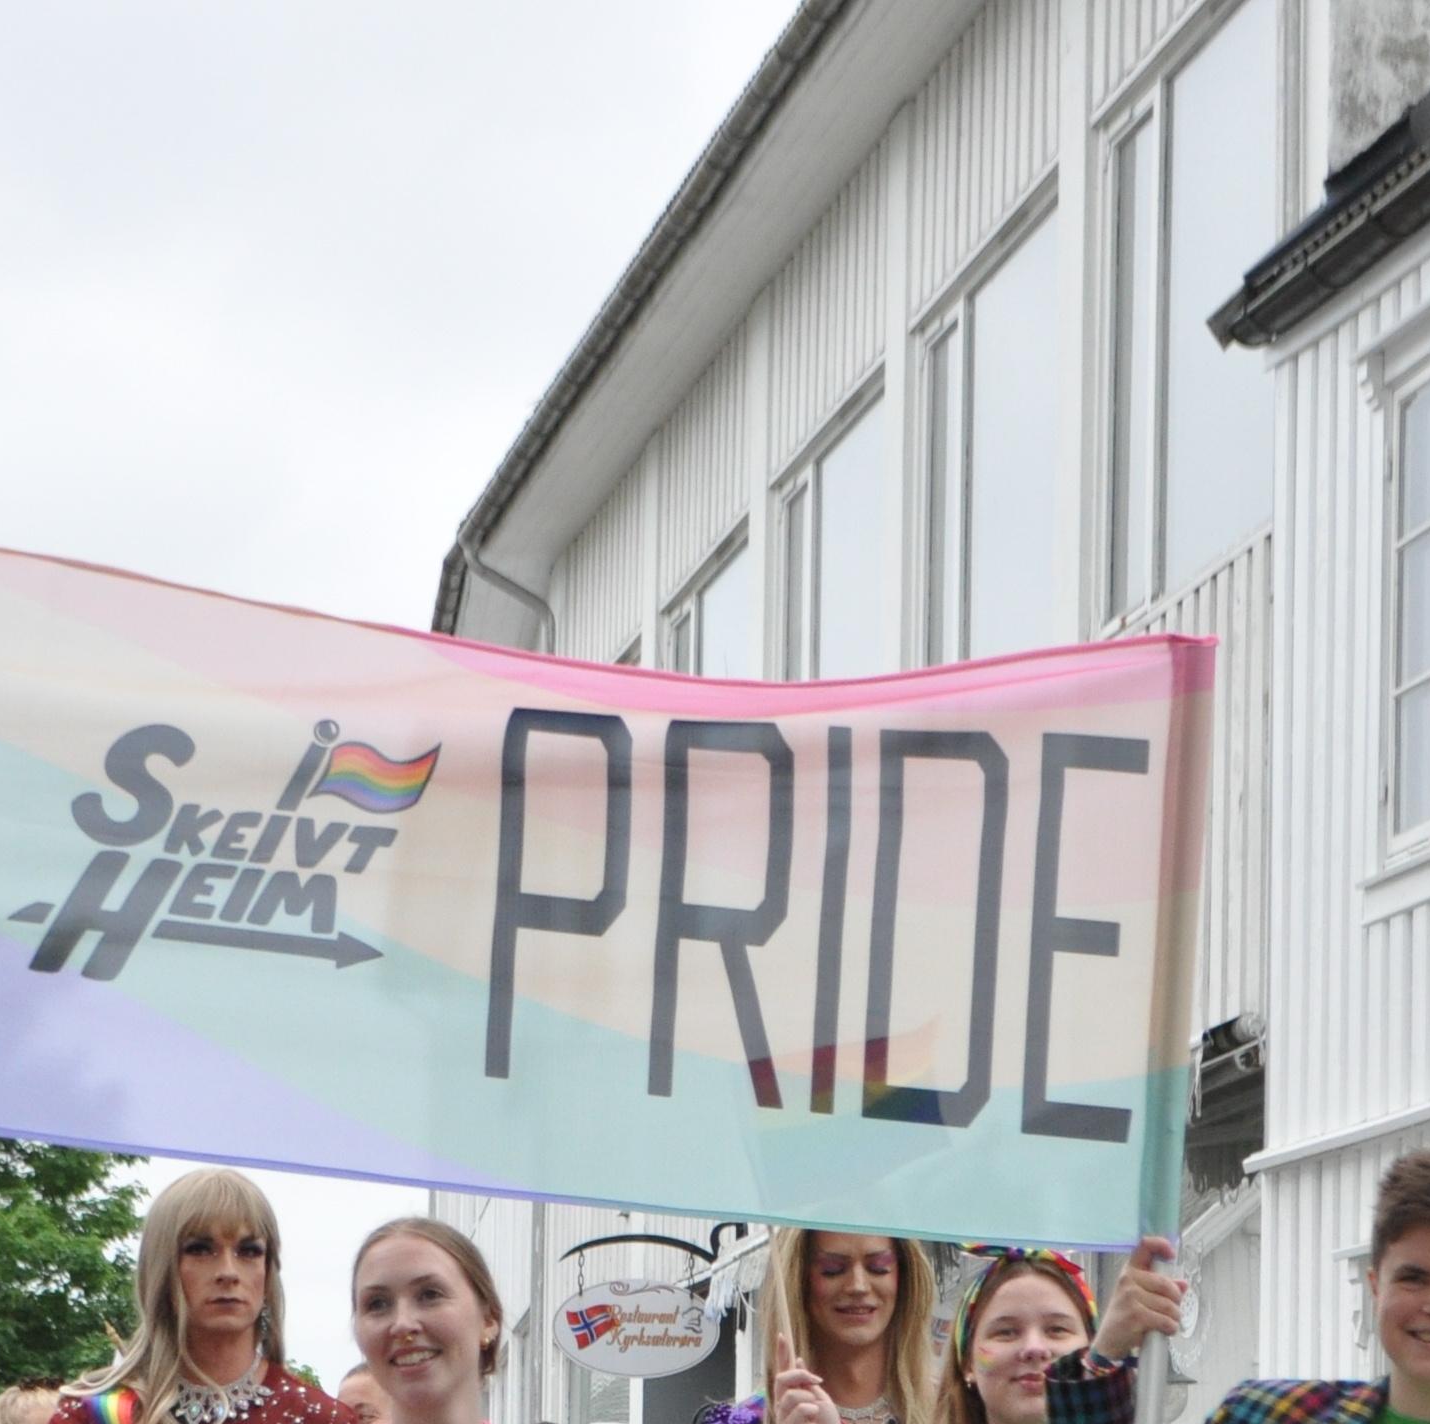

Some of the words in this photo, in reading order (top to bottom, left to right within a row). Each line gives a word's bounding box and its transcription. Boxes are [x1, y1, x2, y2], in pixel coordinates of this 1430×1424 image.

[71, 719, 399, 874] SKEIVT
[28, 849, 338, 981] HEIM
[485, 707, 1150, 1143] PRIDE
[608, 1303, 680, 1325] Restaurant
